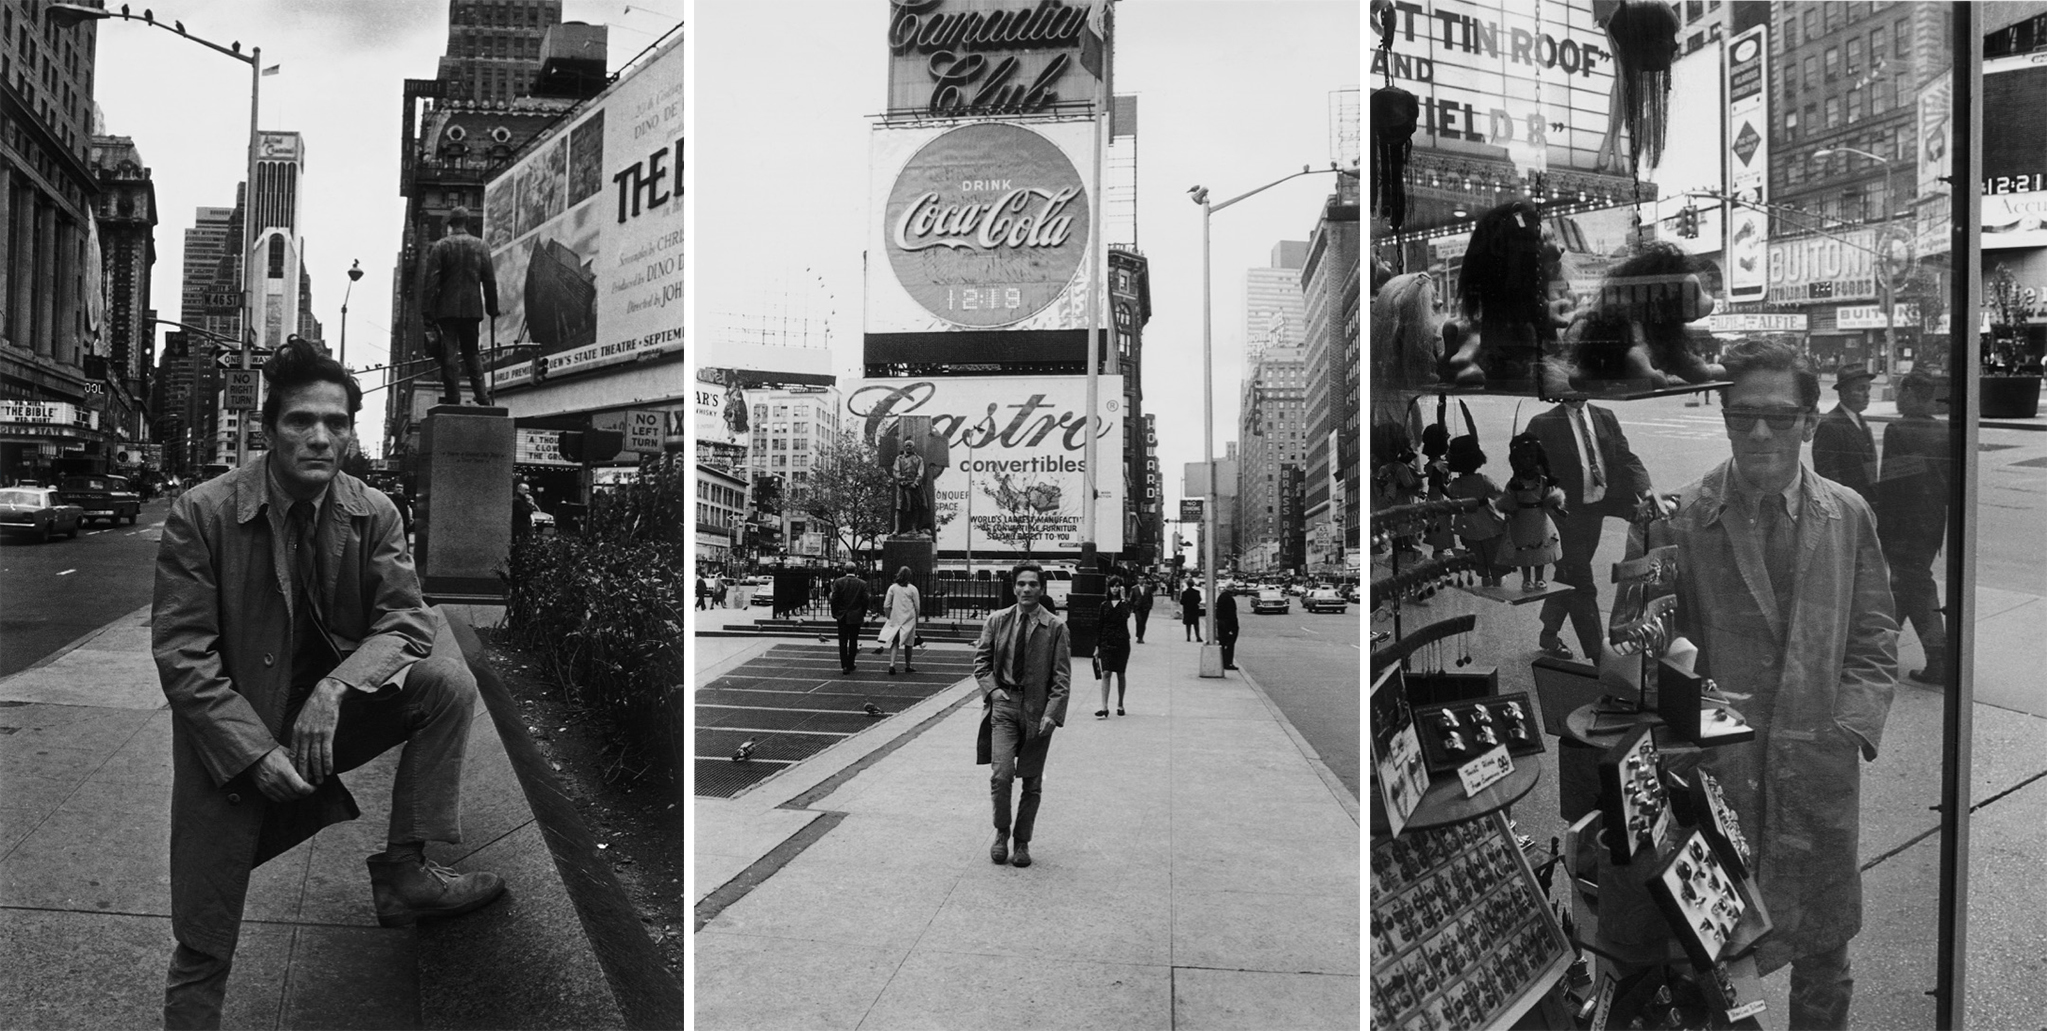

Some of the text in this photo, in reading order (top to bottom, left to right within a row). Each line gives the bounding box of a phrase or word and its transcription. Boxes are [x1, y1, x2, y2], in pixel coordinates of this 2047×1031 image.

[1434, 8, 1499, 59] TIN
[1370, 48, 1434, 84] AND
[928, 50, 1071, 117] Club
[634, 114, 660, 140] DINO
[664, 102, 679, 121] DE
[1412, 95, 1514, 146] IELD
[612, 146, 670, 225] THE
[962, 179, 1012, 192] DRINK
[1987, 173, 2042, 195] 12:21
[893, 185, 1084, 252] Coca-Cola
[657, 228, 684, 252] CHRI
[1769, 231, 1874, 284] BUITONI
[647, 257, 675, 283] DINO
[226, 294, 238, 306] ST
[948, 288, 1021, 310] 12:19
[1770, 285, 1808, 301] ITALIAN
[1833, 279, 1872, 296] FOODS
[1764, 315, 1798, 331] ALFIE
[224, 356, 242, 364] ONE
[574, 349, 598, 366] STATE
[601, 339, 637, 358] THEATRE
[233, 374, 251, 384] NO
[230, 386, 254, 396] RIGHT
[231, 397, 252, 406] TURN
[636, 413, 657, 425] NO
[847, 381, 1113, 451] Castro
[632, 427, 659, 437] LEFT
[632, 437, 658, 447] TURN
[529, 452, 543, 460] THE
[959, 455, 1086, 474] convertibles
[1146, 419, 1156, 499] HOWARD
[1282, 469, 1291, 556] BRASS RAIL
